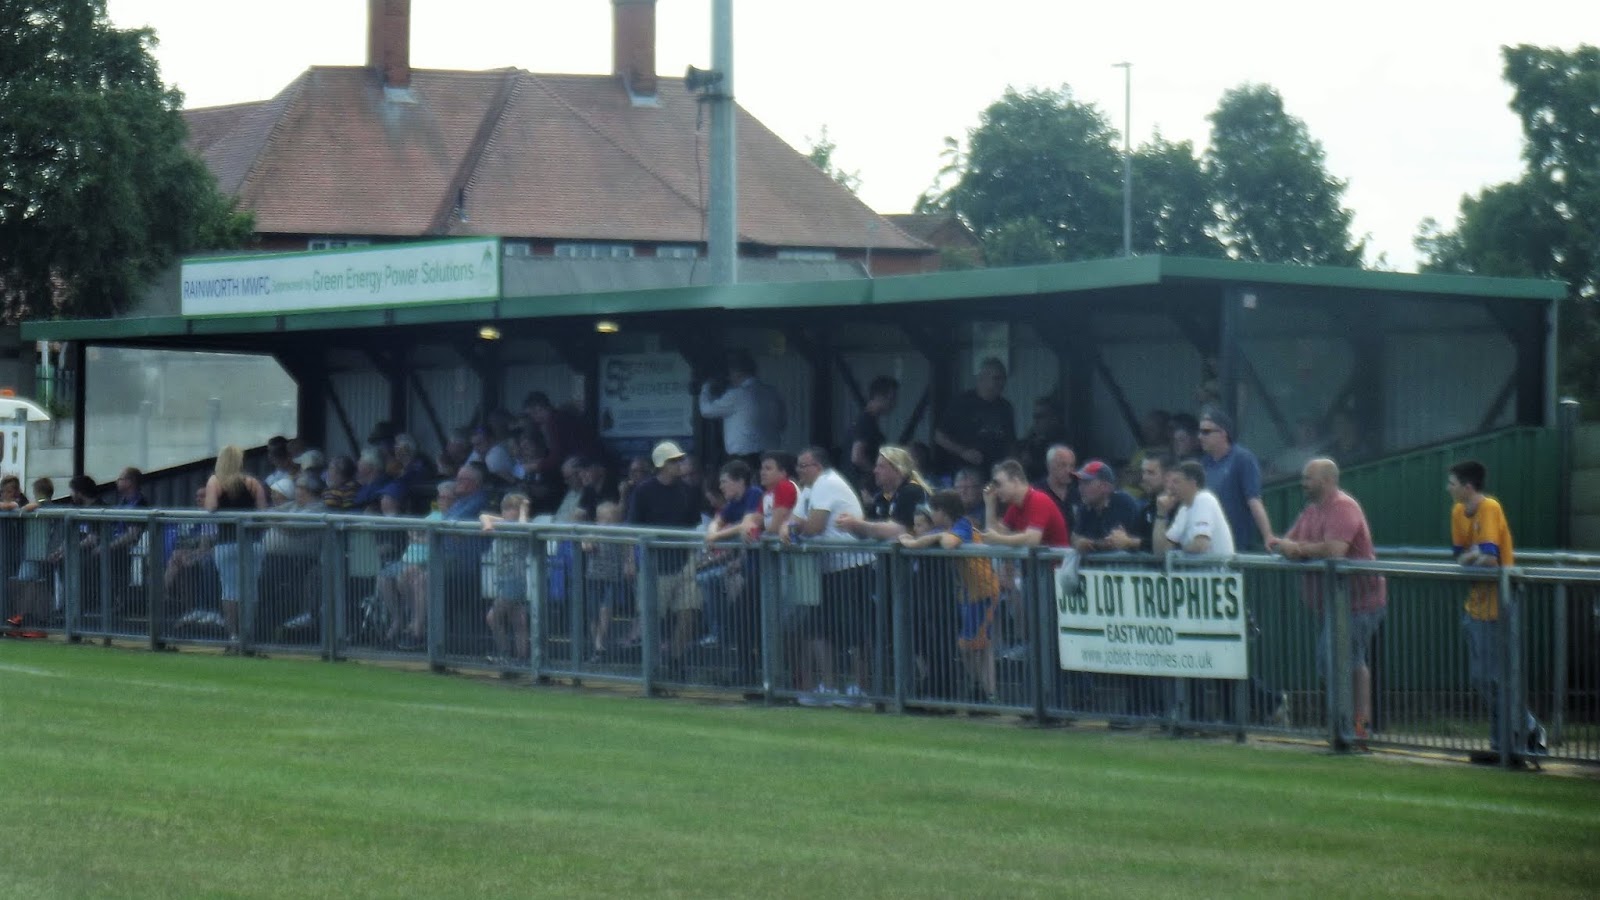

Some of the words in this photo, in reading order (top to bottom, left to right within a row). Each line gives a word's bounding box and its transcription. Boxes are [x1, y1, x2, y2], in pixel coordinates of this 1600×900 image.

[183, 277, 239, 299] RAINWORTH
[241, 275, 271, 297] MWFC
[312, 269, 343, 292] Green
[346, 268, 382, 293] Energy
[385, 264, 419, 287] Power
[421, 261, 474, 284] Solutions
[1094, 574, 1125, 618] LOT
[1130, 575, 1240, 620] TROPHIES
[1106, 624, 1174, 646] EASTWOOD
